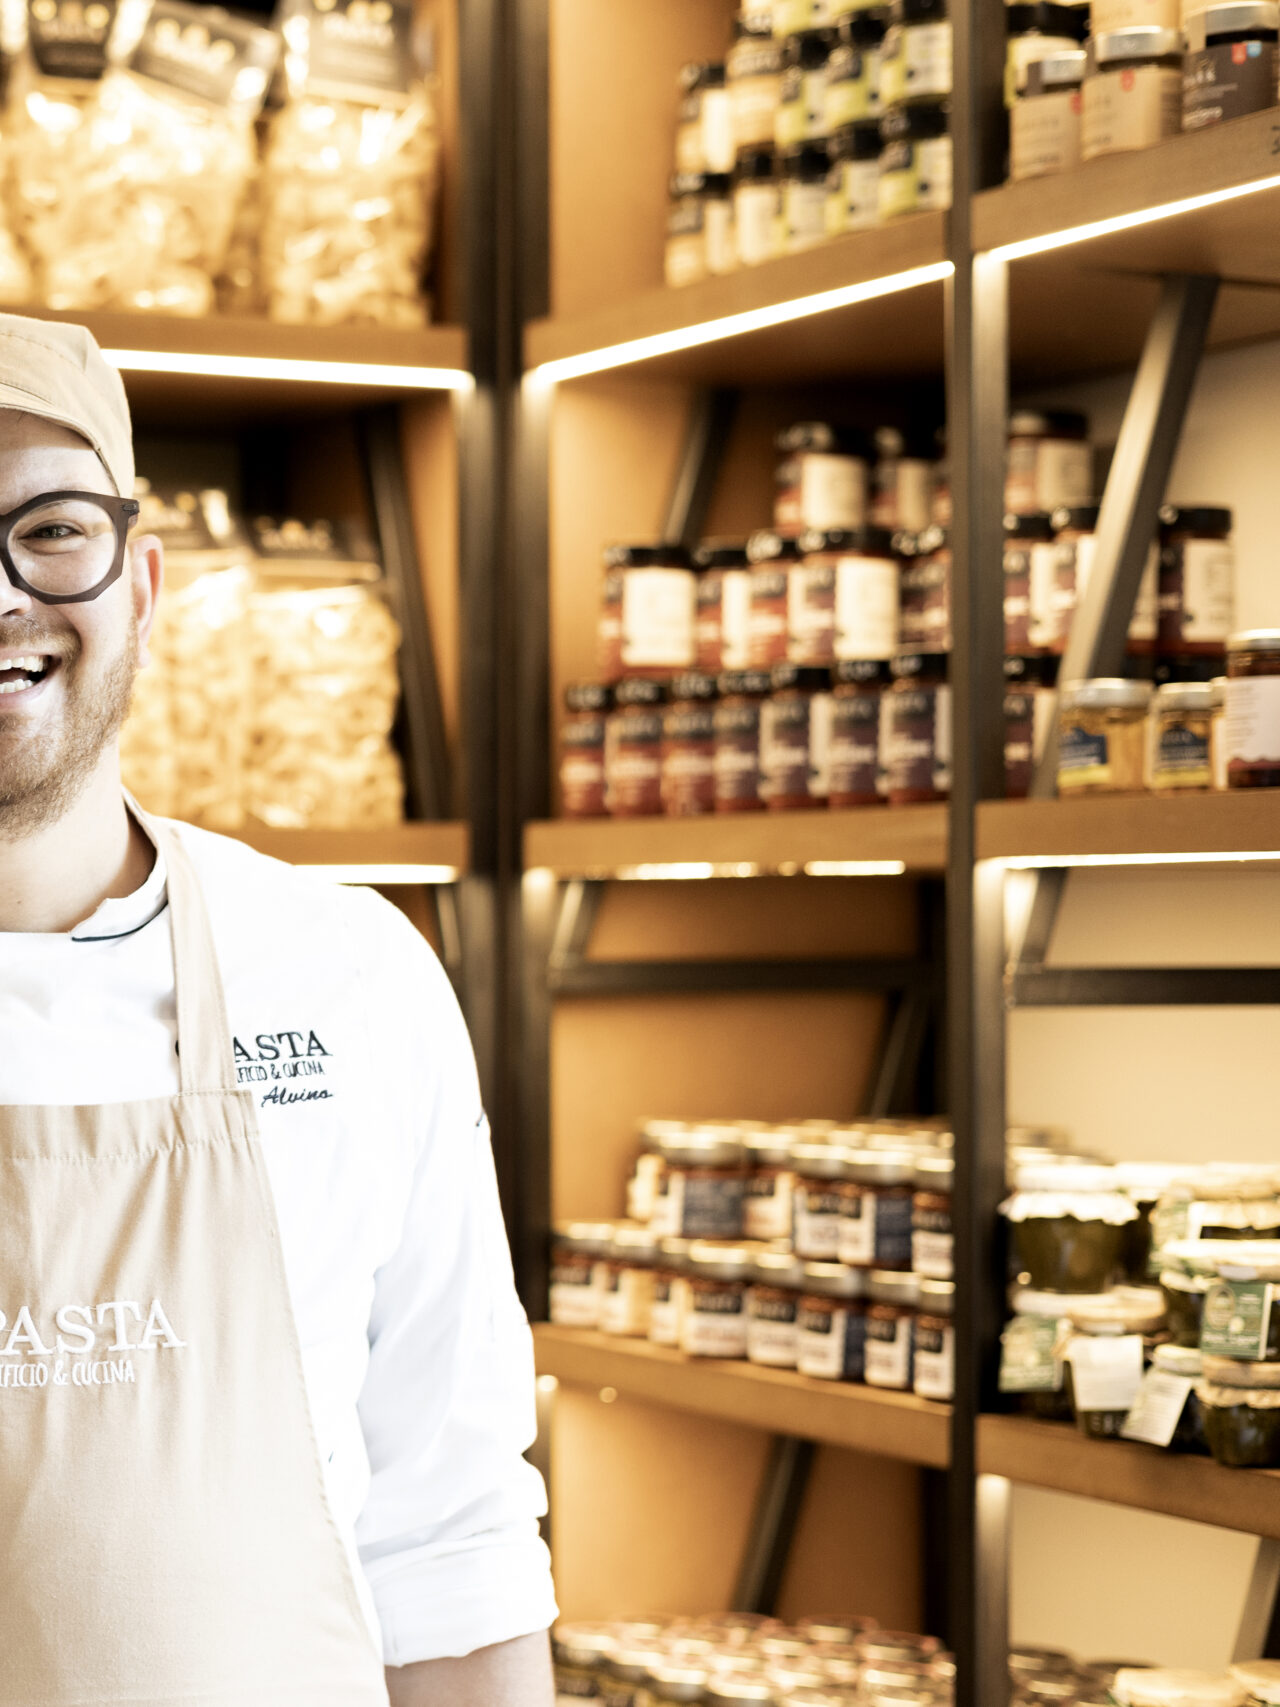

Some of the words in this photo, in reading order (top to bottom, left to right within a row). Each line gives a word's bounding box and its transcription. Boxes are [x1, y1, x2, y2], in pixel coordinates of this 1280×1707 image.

[233, 1030, 333, 1062] ASTA
[236, 1066, 268, 1083] FICIO
[270, 1063, 282, 1080] &
[283, 1060, 325, 1078] CUCINA
[53, 1359, 68, 1386] &
[72, 1359, 136, 1386] CUCINA
